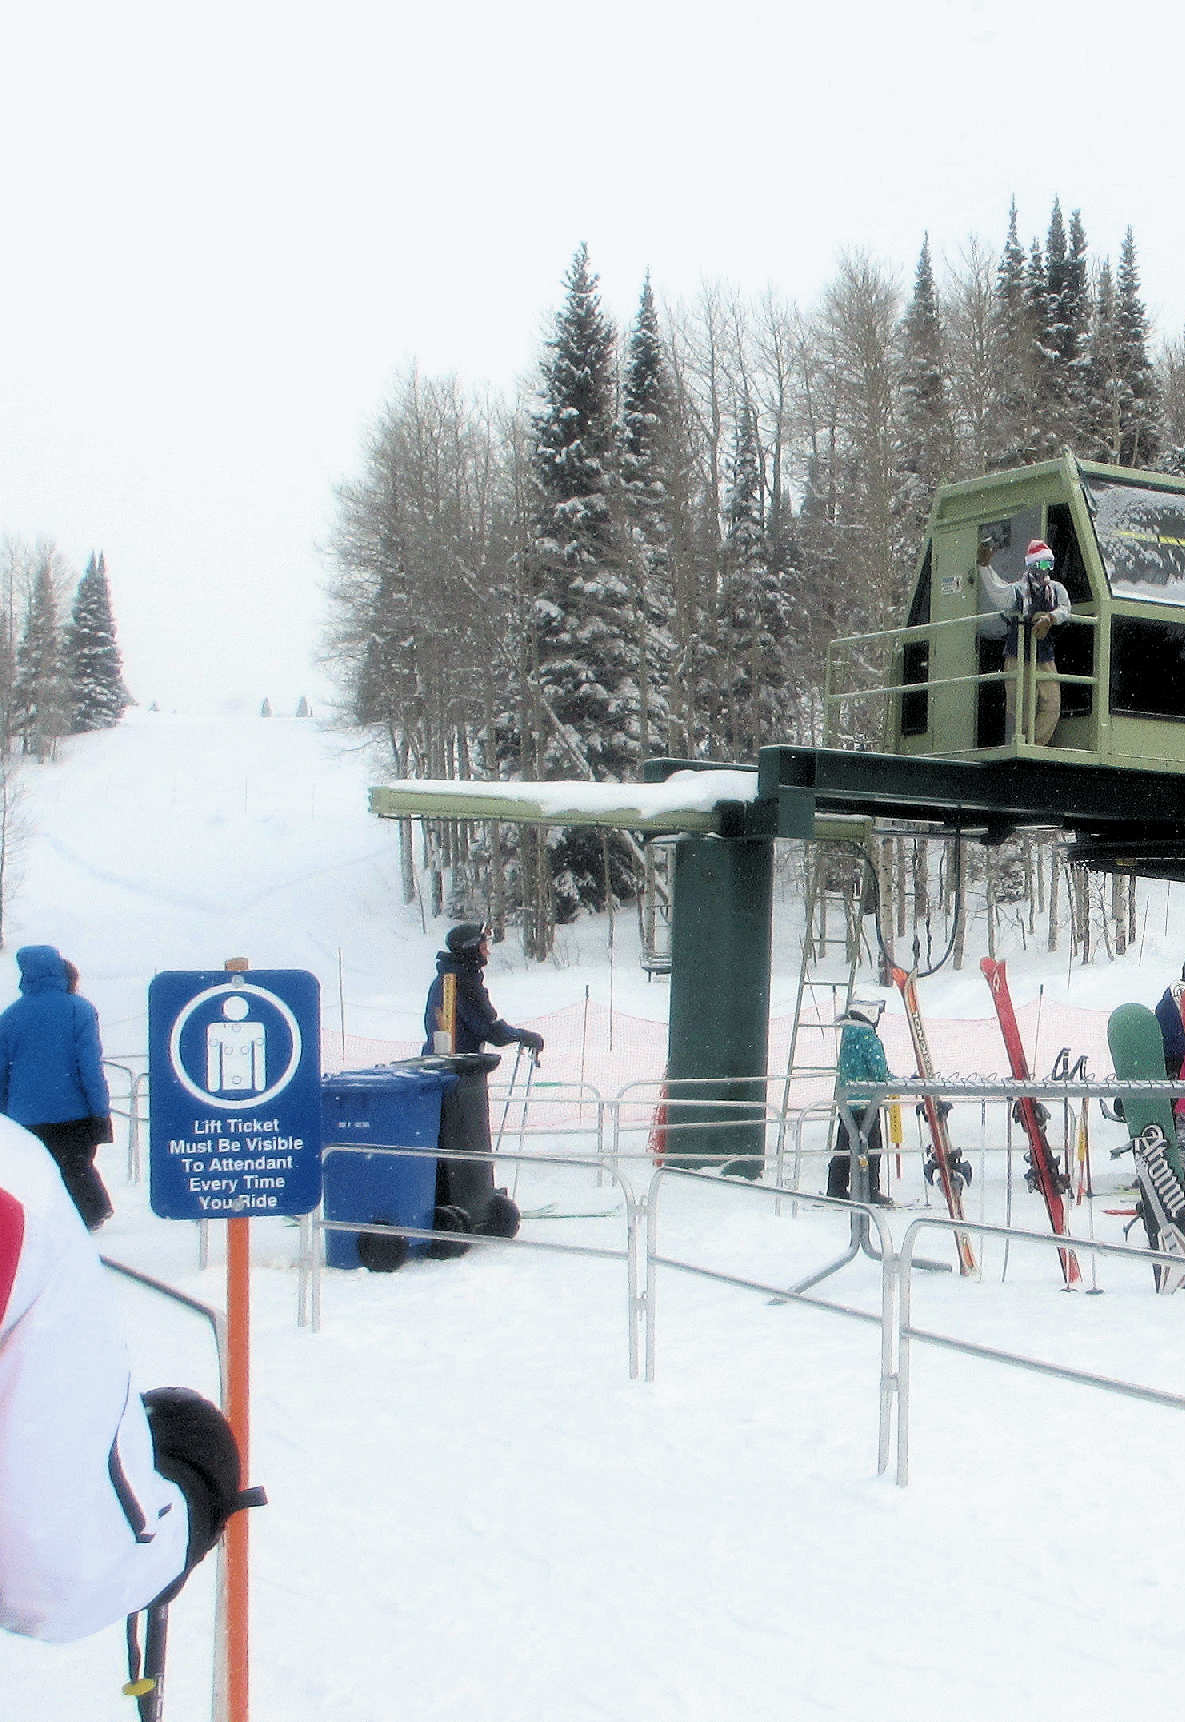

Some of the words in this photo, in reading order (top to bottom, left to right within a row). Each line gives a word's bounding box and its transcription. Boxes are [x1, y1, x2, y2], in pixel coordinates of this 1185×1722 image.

[193, 1119, 222, 1135] Lift
[227, 1118, 280, 1134] Ticket
[169, 1139, 212, 1155] Must
[218, 1138, 241, 1153] Be
[246, 1136, 304, 1151] Visible
[181, 1158, 204, 1173] To
[209, 1156, 293, 1172] Attendant
[189, 1176, 238, 1193] Every
[243, 1175, 286, 1190] Time
[199, 1196, 232, 1211] You
[242, 1194, 278, 1210] Ride
